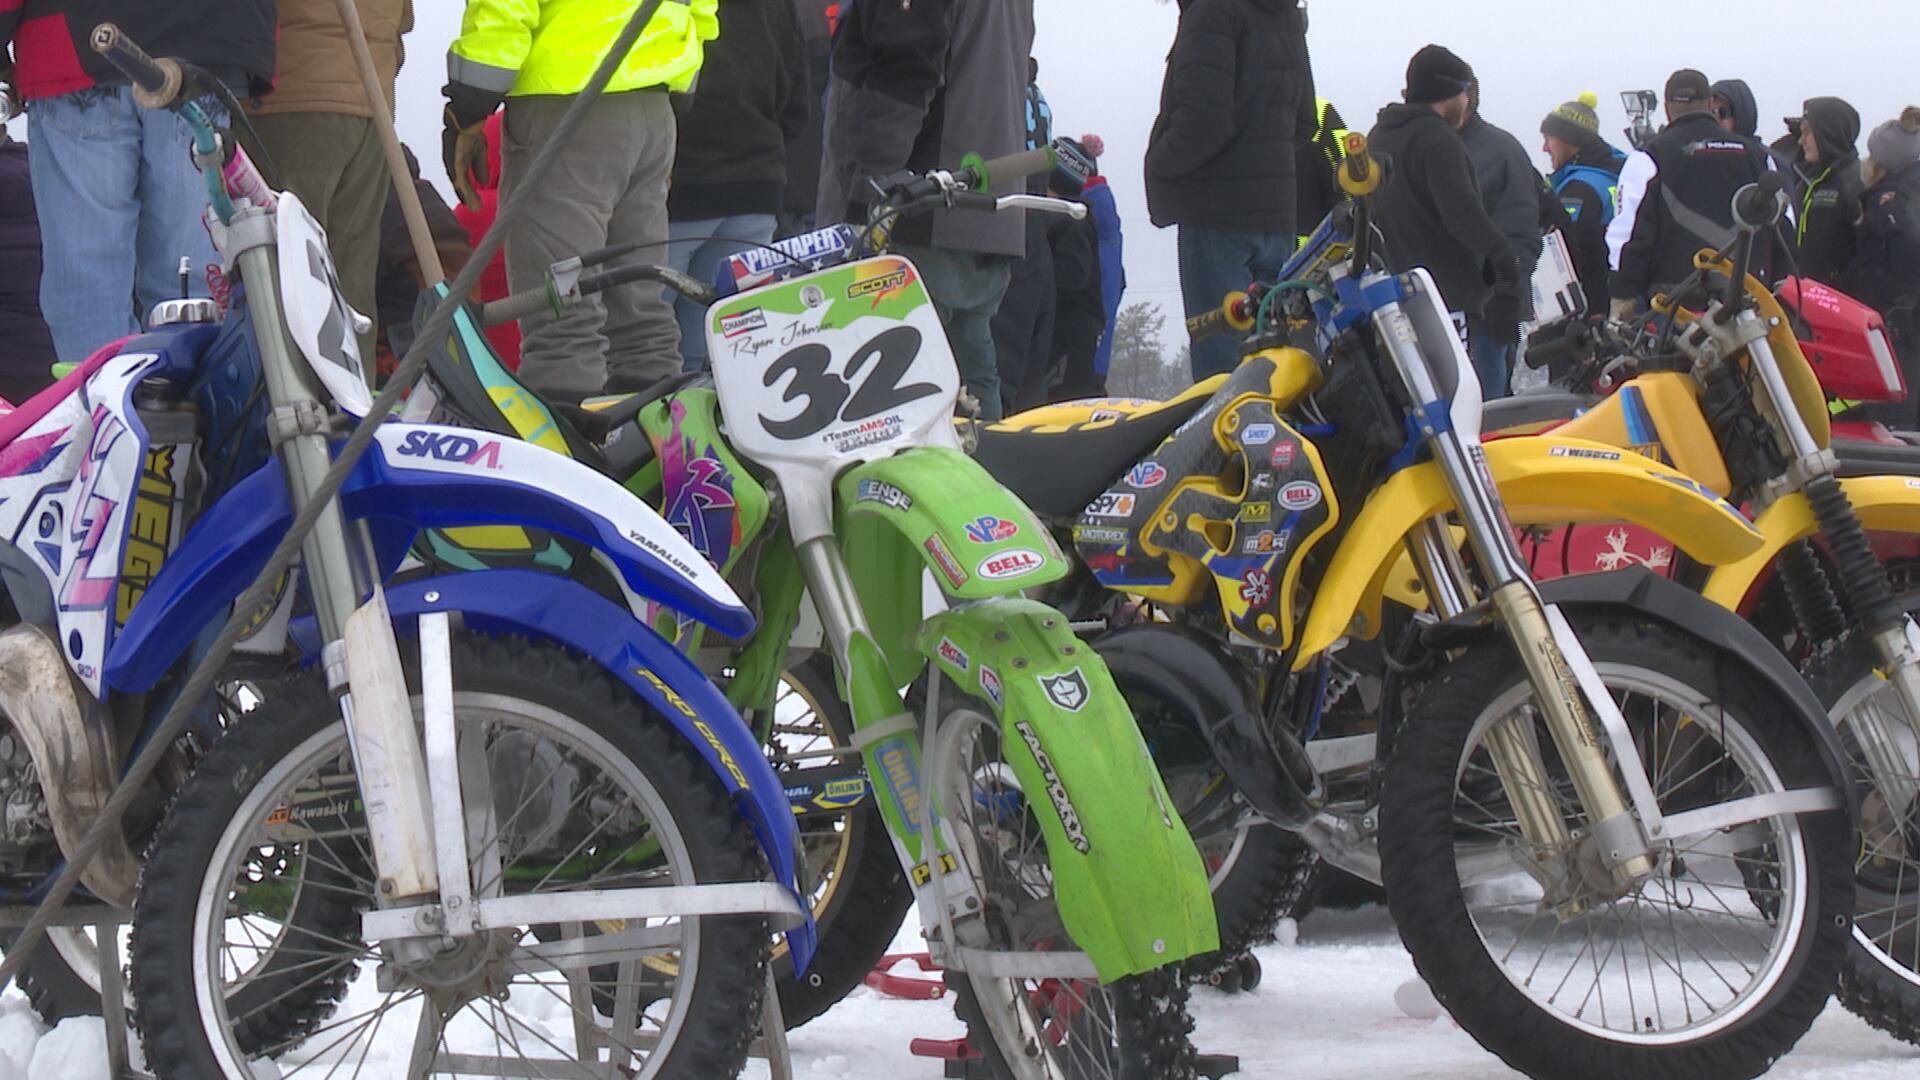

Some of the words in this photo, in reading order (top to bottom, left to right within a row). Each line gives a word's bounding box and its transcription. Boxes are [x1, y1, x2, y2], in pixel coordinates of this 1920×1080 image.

[746, 227, 840, 273] PROTAPER
[848, 271, 906, 299] SCOTT
[723, 315, 764, 333] CHAMPION
[758, 325, 943, 440] 32
[396, 430, 502, 469] SKDA
[1568, 448, 1621, 461] WISECO
[1133, 463, 1156, 485] VP
[1286, 488, 1313, 501] BELL
[965, 515, 999, 542] VP
[628, 529, 699, 580] YAMALUBE
[986, 553, 1036, 575] BELL
[636, 667, 696, 718] PRO
[290, 799, 350, 820] Kawasaki
